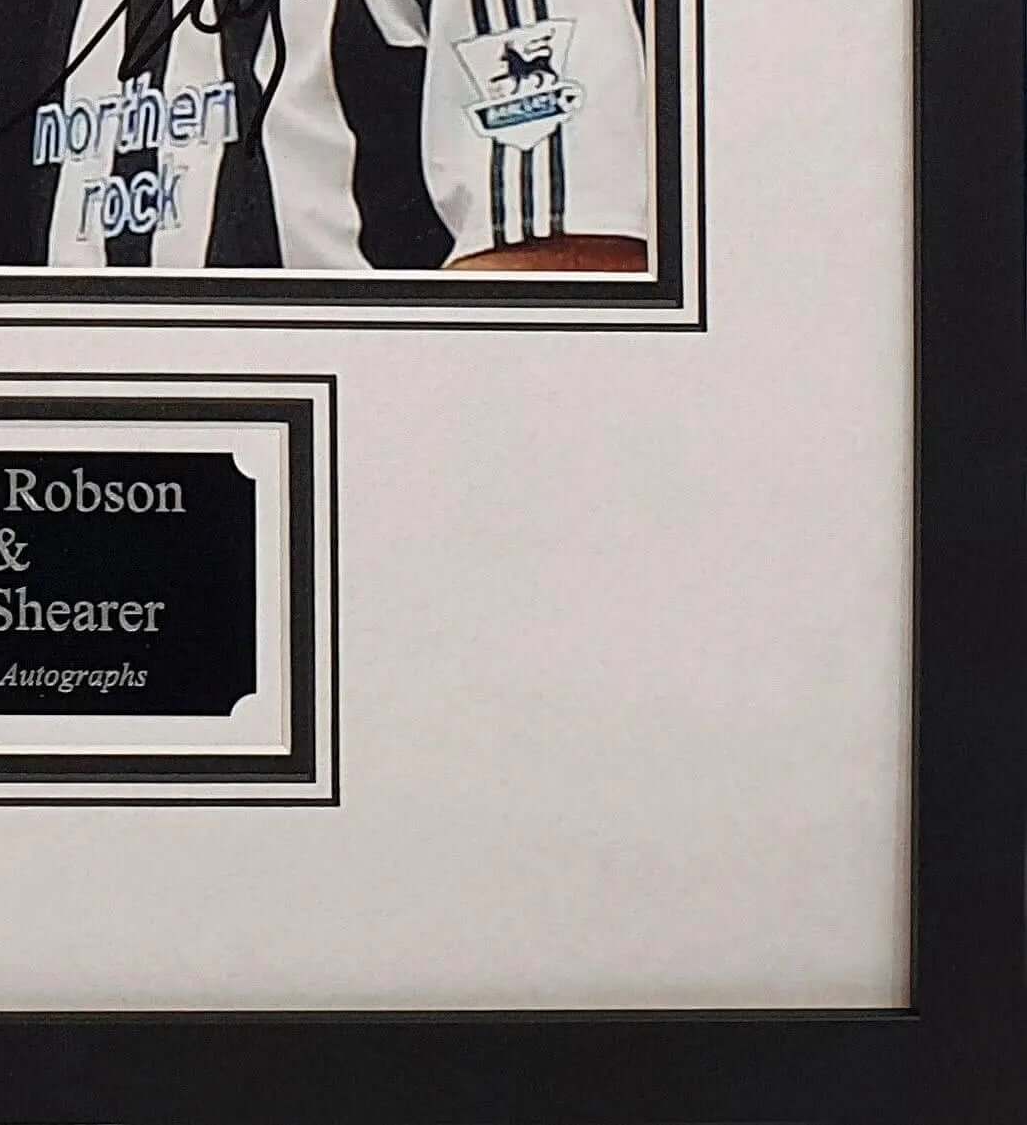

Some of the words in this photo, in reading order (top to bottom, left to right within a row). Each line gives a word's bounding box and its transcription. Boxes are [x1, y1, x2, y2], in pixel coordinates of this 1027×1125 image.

[76, 164, 185, 241] rock
[3, 468, 186, 513] Robson
[0, 663, 147, 694] Autographs
